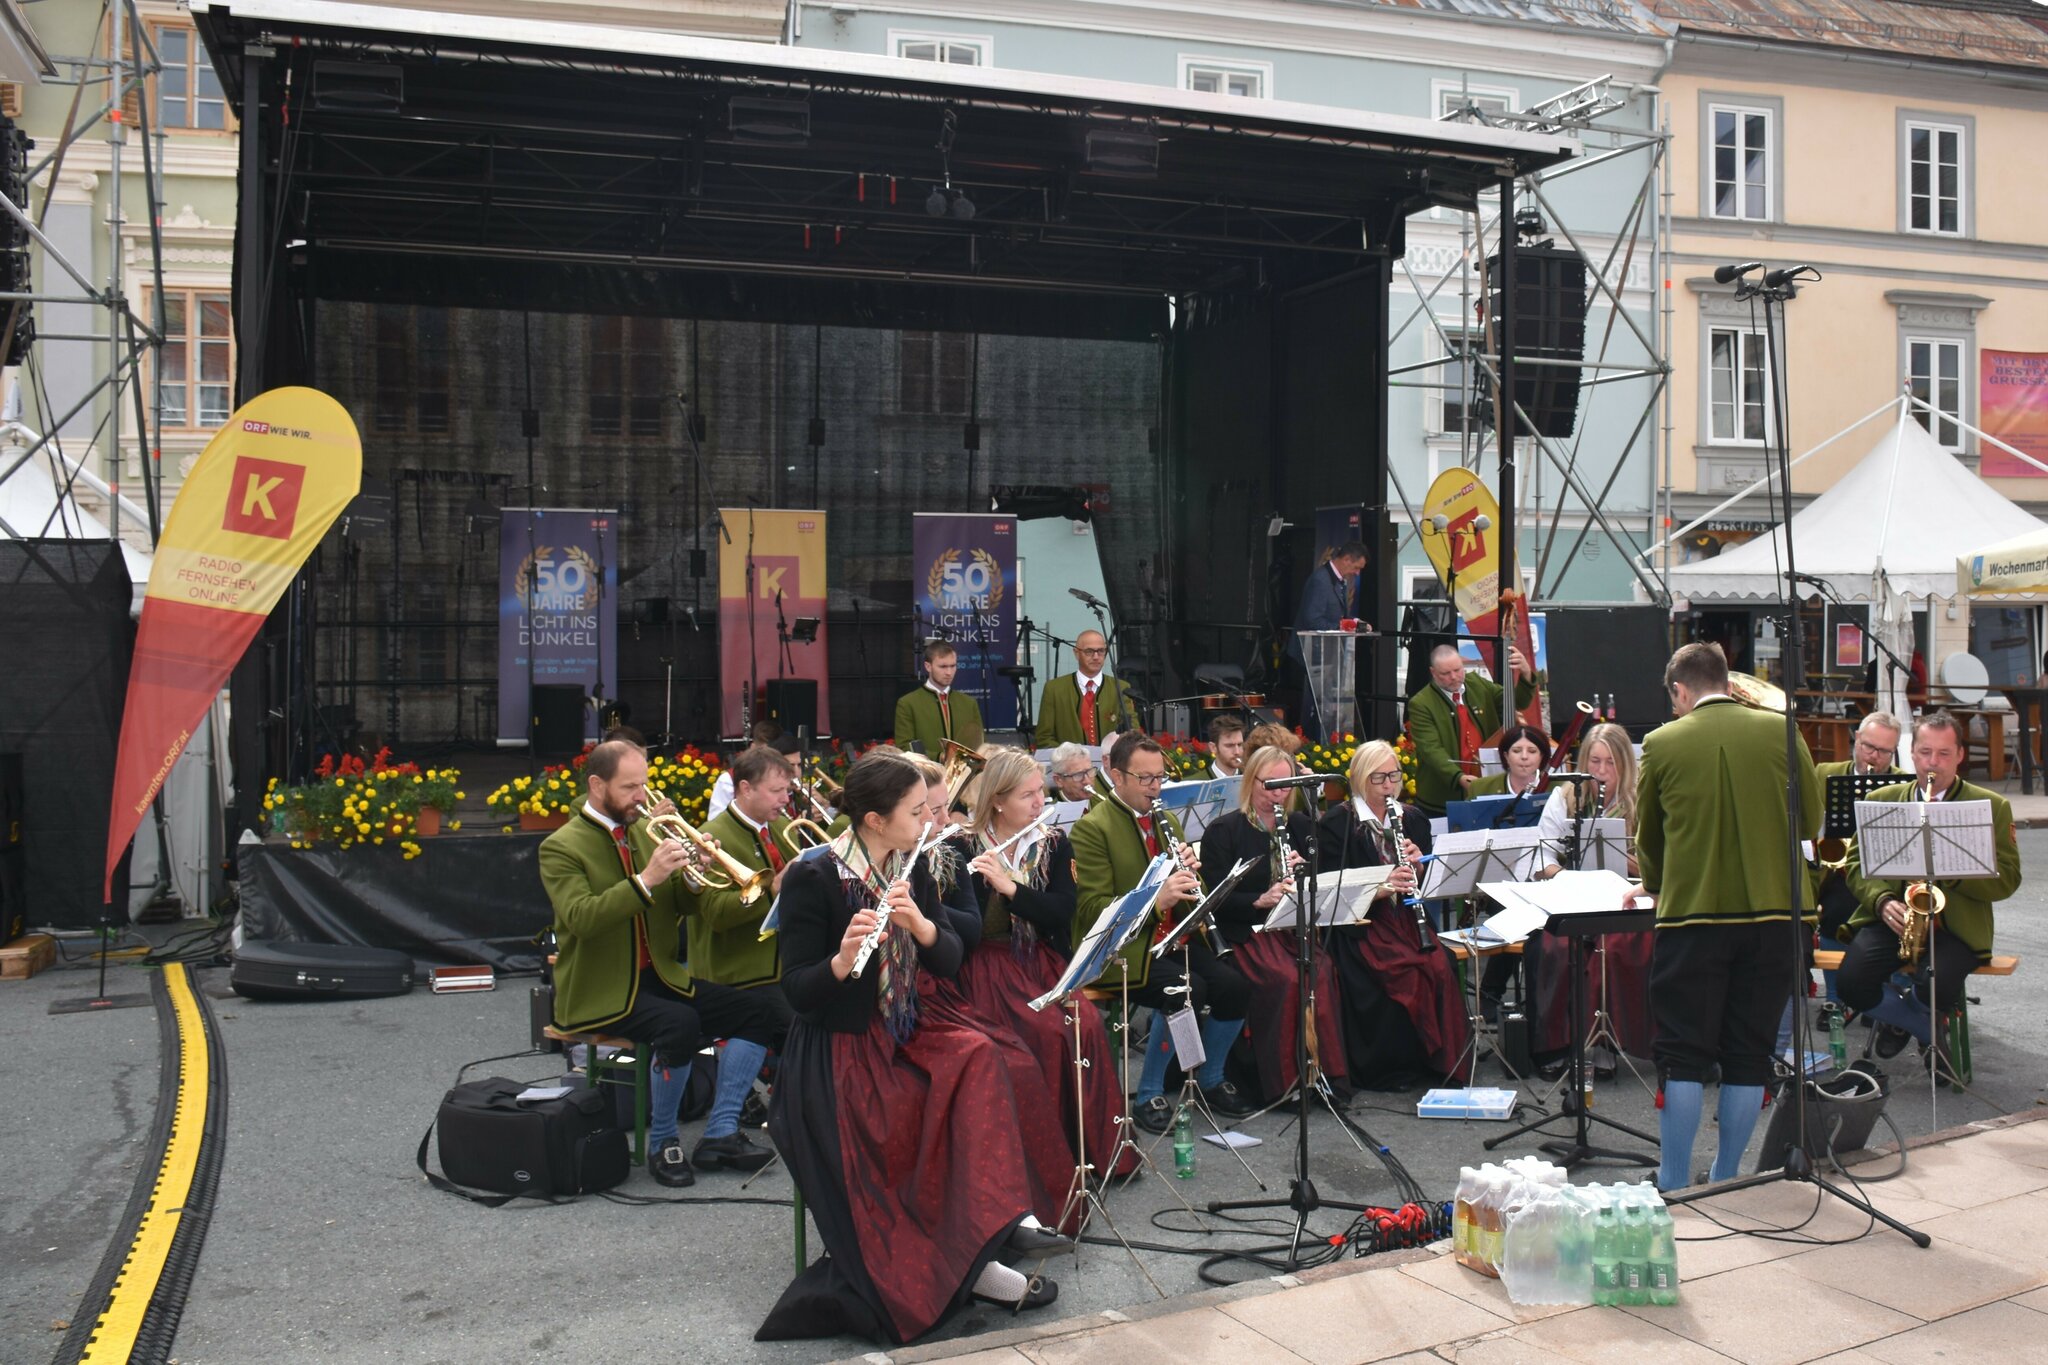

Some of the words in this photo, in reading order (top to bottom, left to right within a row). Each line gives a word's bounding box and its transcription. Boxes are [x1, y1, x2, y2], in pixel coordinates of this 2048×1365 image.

[244, 421, 269, 433] ORF
[270, 426, 288, 436] WIE
[291, 428, 312, 439] WIR.
[241, 472, 285, 520] K
[199, 556, 242, 573] RADIO
[177, 568, 256, 592] FERNSEHEN
[536, 560, 585, 593] 50
[759, 567, 788, 600] K
[942, 562, 990, 593] 50
[189, 586, 239, 605] ONLINE
[531, 595, 585, 611] JAHRE
[942, 594, 989, 610] JAHRE
[519, 616, 569, 629] LCHT
[570, 616, 597, 629] INS
[931, 614, 973, 627] LICHT
[978, 614, 1000, 627] NS
[134, 729, 190, 815] kaernten.ORF.at
